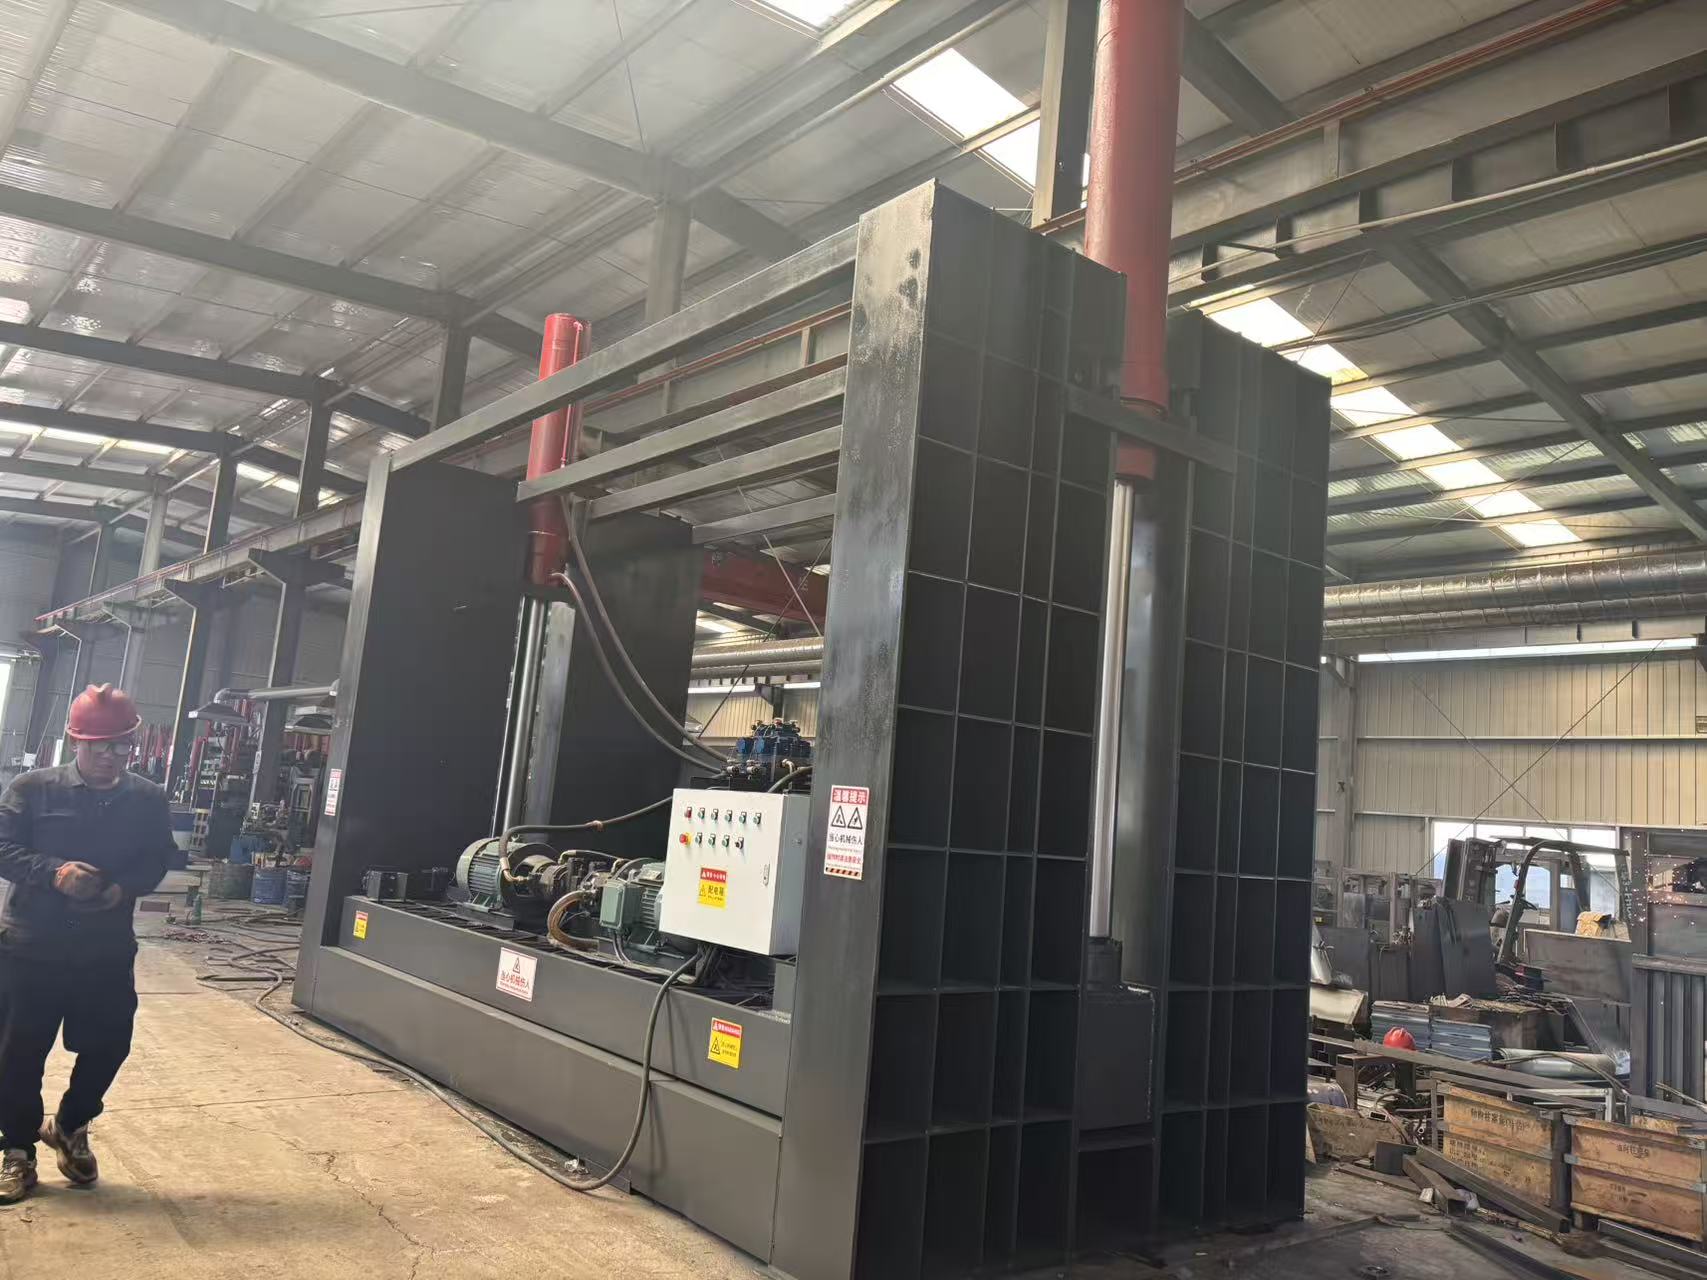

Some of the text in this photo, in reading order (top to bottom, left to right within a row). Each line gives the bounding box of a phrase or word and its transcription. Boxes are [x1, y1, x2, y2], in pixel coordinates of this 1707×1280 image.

[828, 832, 863, 846] 当心机械伤人
